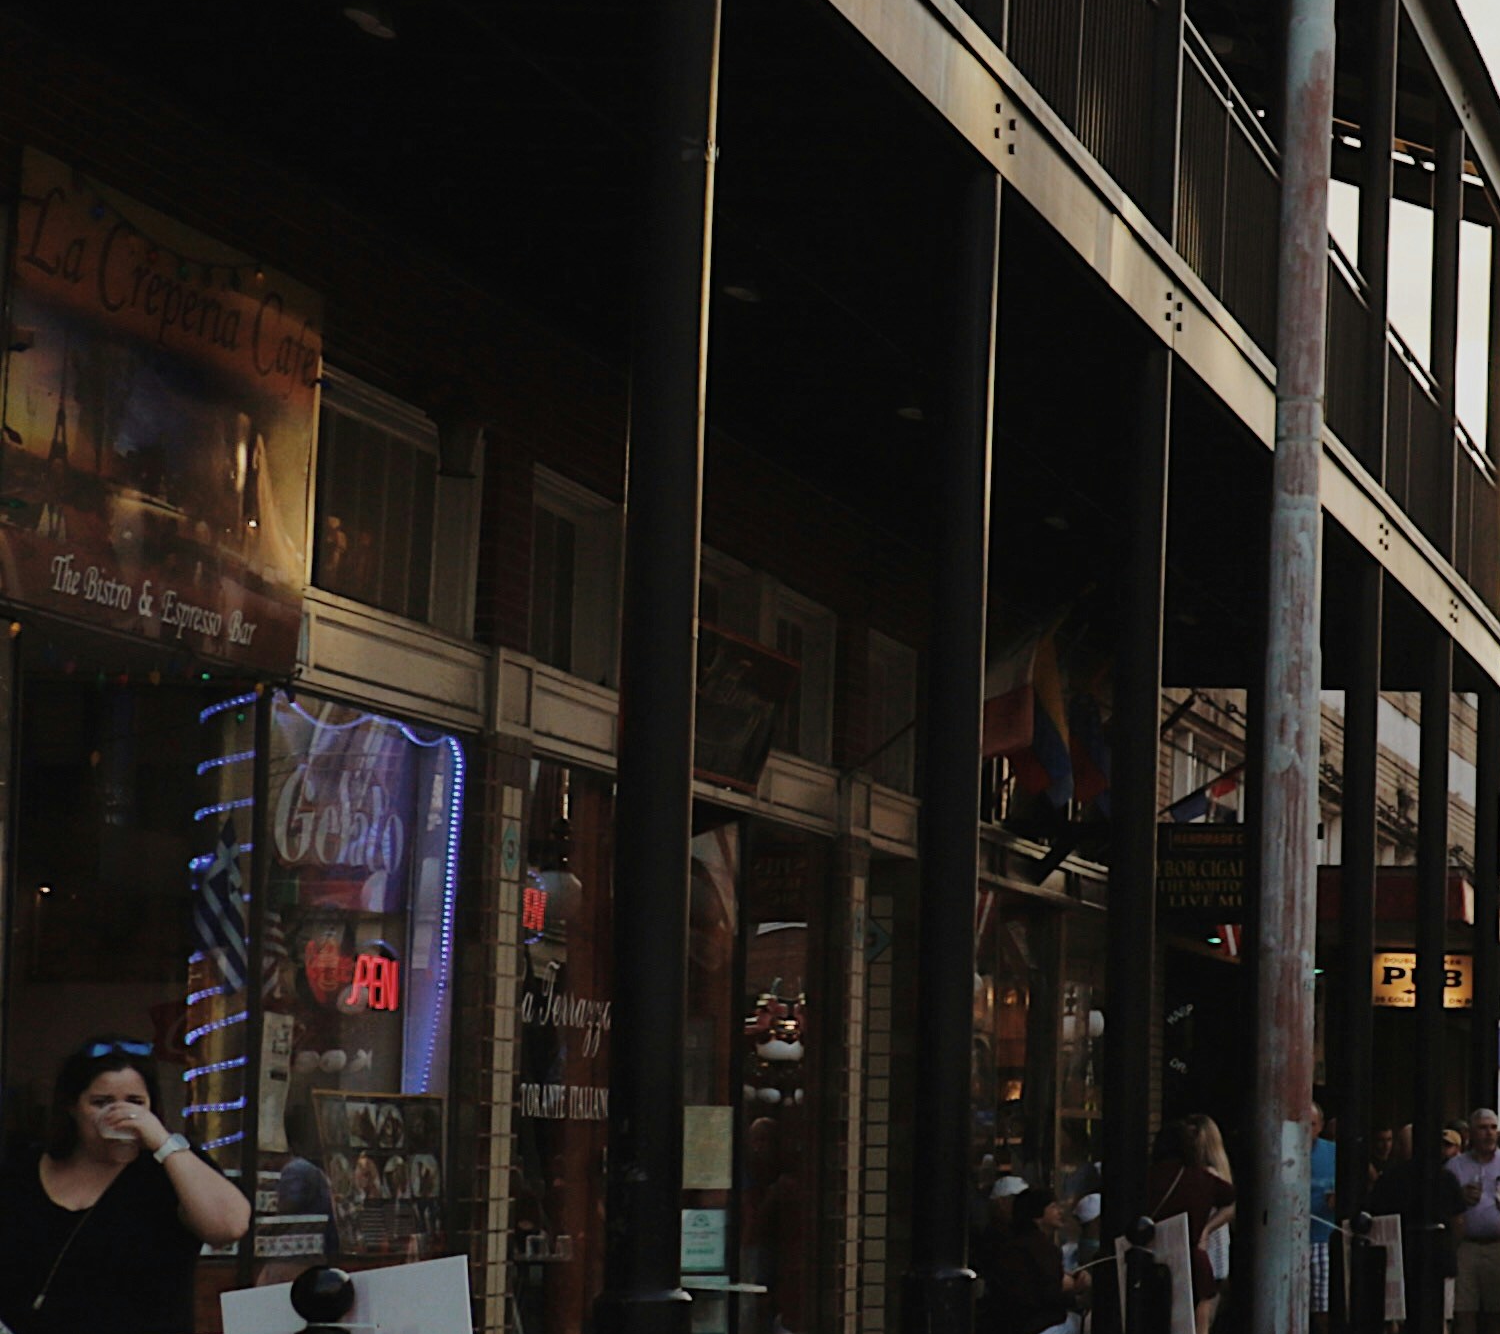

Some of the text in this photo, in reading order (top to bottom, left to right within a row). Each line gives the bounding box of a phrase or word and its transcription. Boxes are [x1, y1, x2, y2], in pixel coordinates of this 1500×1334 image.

[20, 187, 86, 284] La
[51, 553, 257, 647] The Bistro & Espresso Bar
[274, 763, 404, 874] Gelato
[345, 953, 400, 1011] PEN
